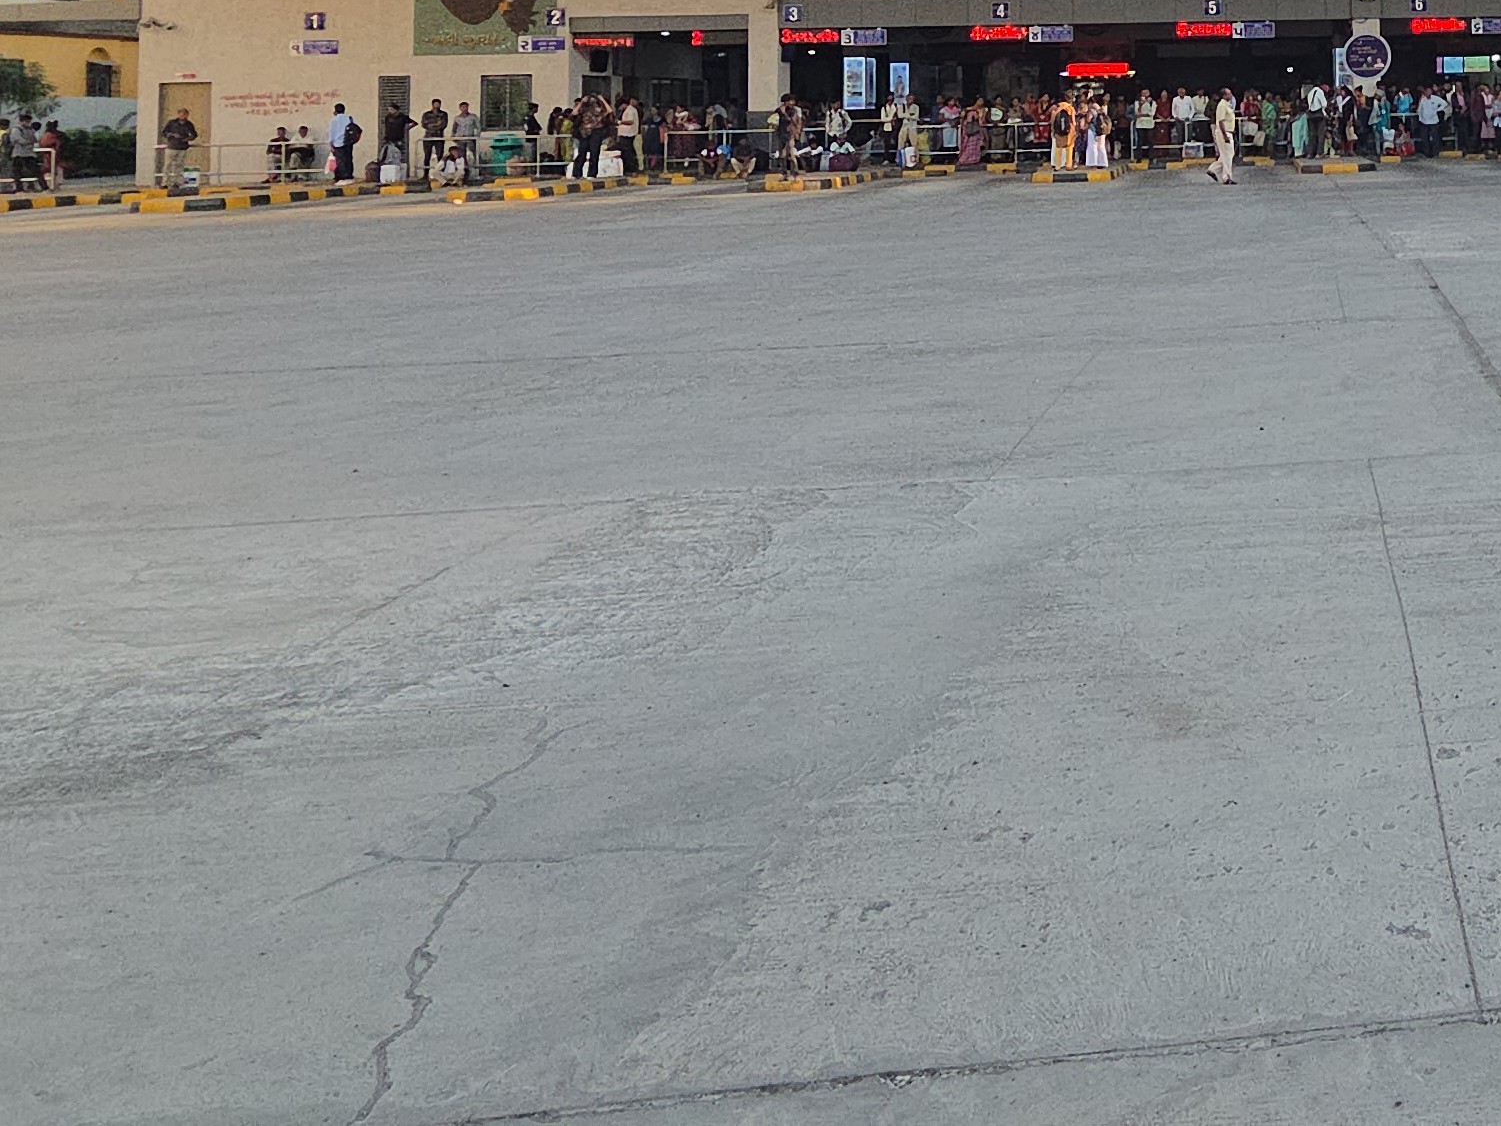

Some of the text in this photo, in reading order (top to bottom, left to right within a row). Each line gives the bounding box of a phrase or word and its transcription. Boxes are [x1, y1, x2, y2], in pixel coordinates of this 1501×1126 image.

[788, 6, 798, 21] 3
[996, 4, 1005, 18] 4
[1208, 0, 1217, 15] 5
[309, 14, 319, 29] 1
[550, 9, 562, 25] 2
